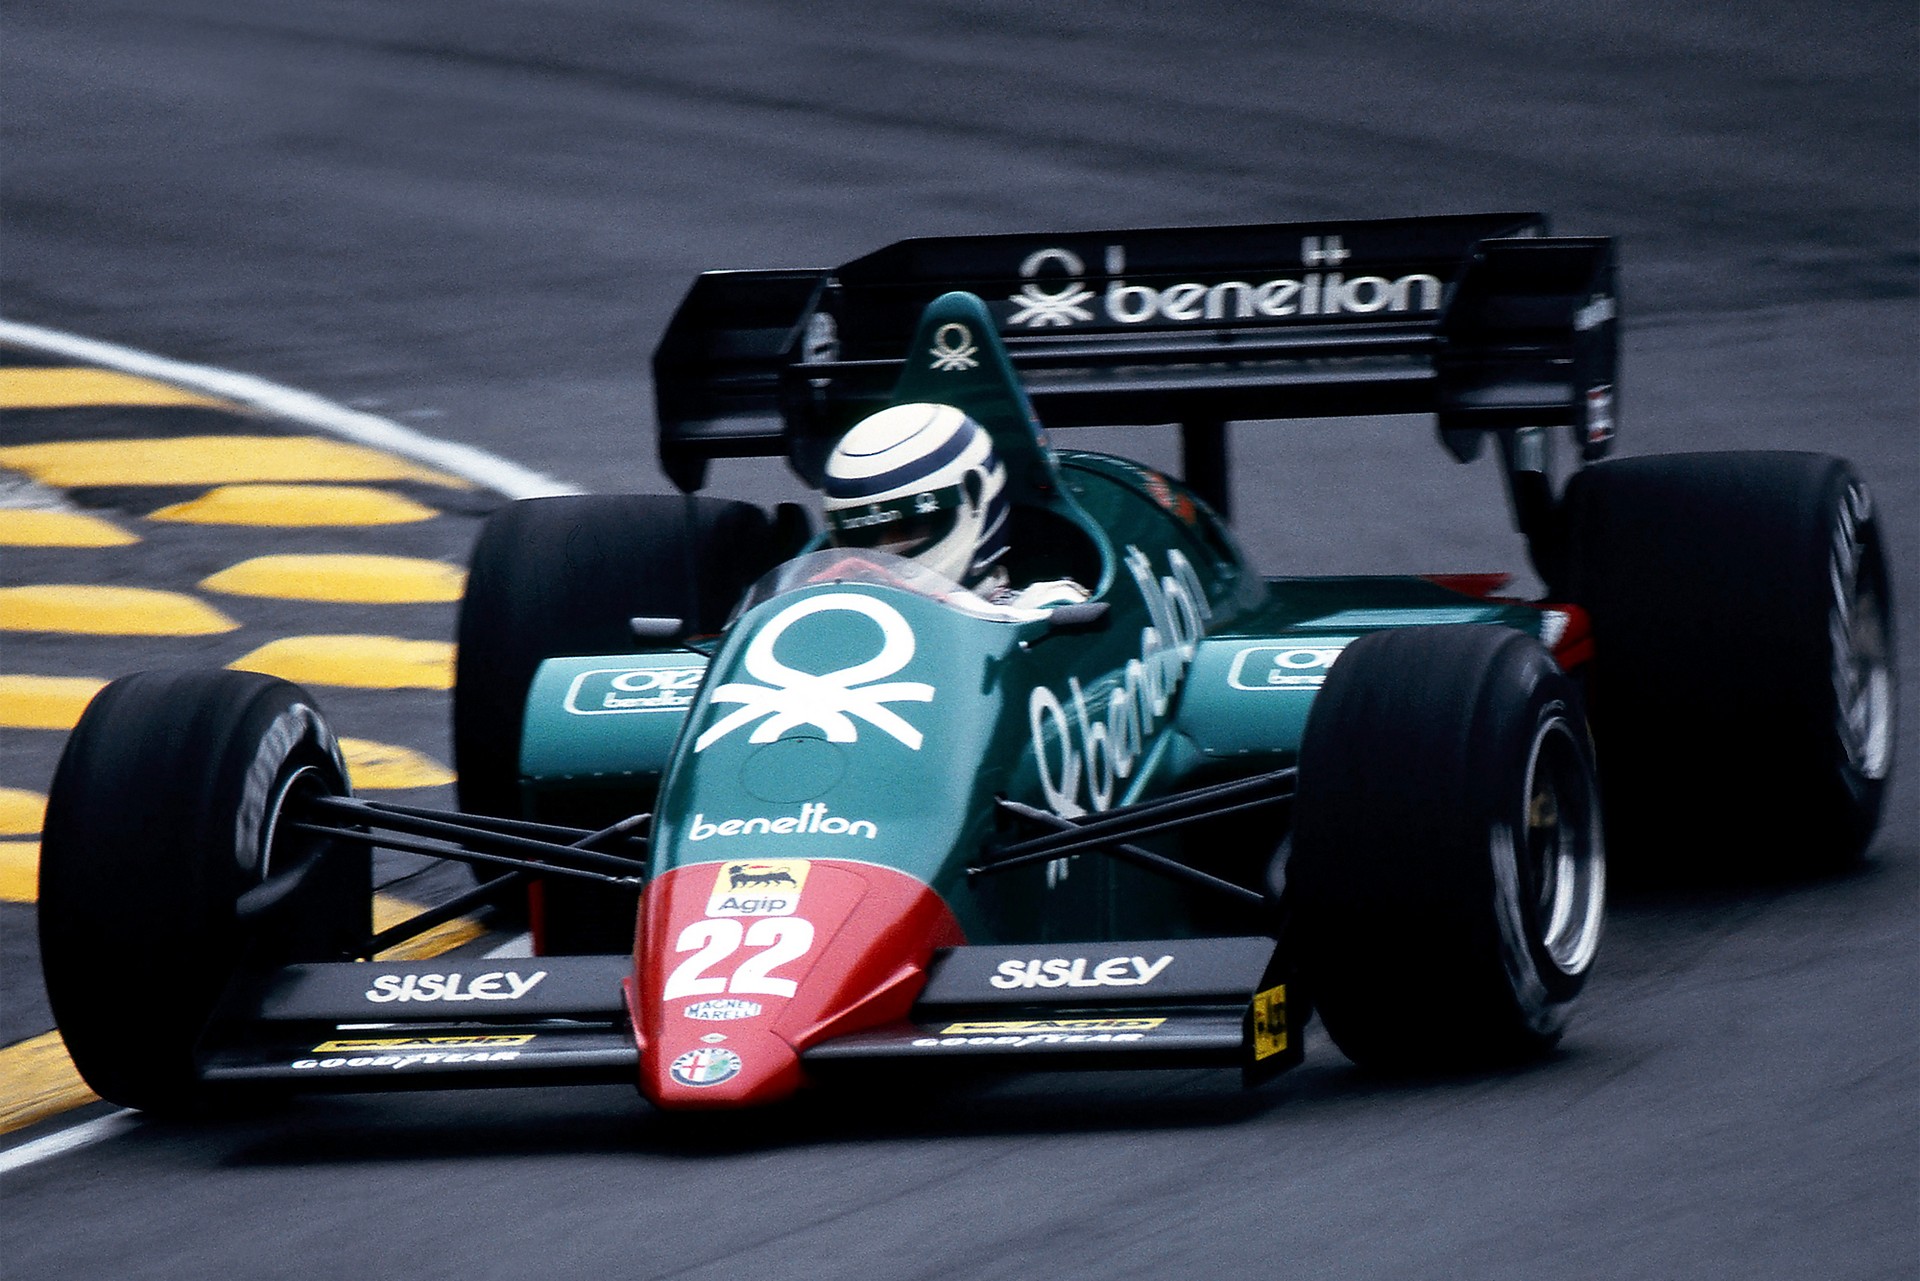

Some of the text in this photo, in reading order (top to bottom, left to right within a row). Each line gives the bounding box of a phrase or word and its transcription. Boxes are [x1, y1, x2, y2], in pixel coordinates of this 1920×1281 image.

[1105, 235, 1442, 323] benetton
[689, 803, 877, 841] benetton
[718, 897, 787, 913] Agip
[663, 917, 815, 1001] 22
[990, 955, 1174, 989] SISLEY
[365, 971, 548, 1002] SISLEY
[912, 1033, 1145, 1047] GOODYEAR
[292, 1052, 520, 1069] GOODYEAR
